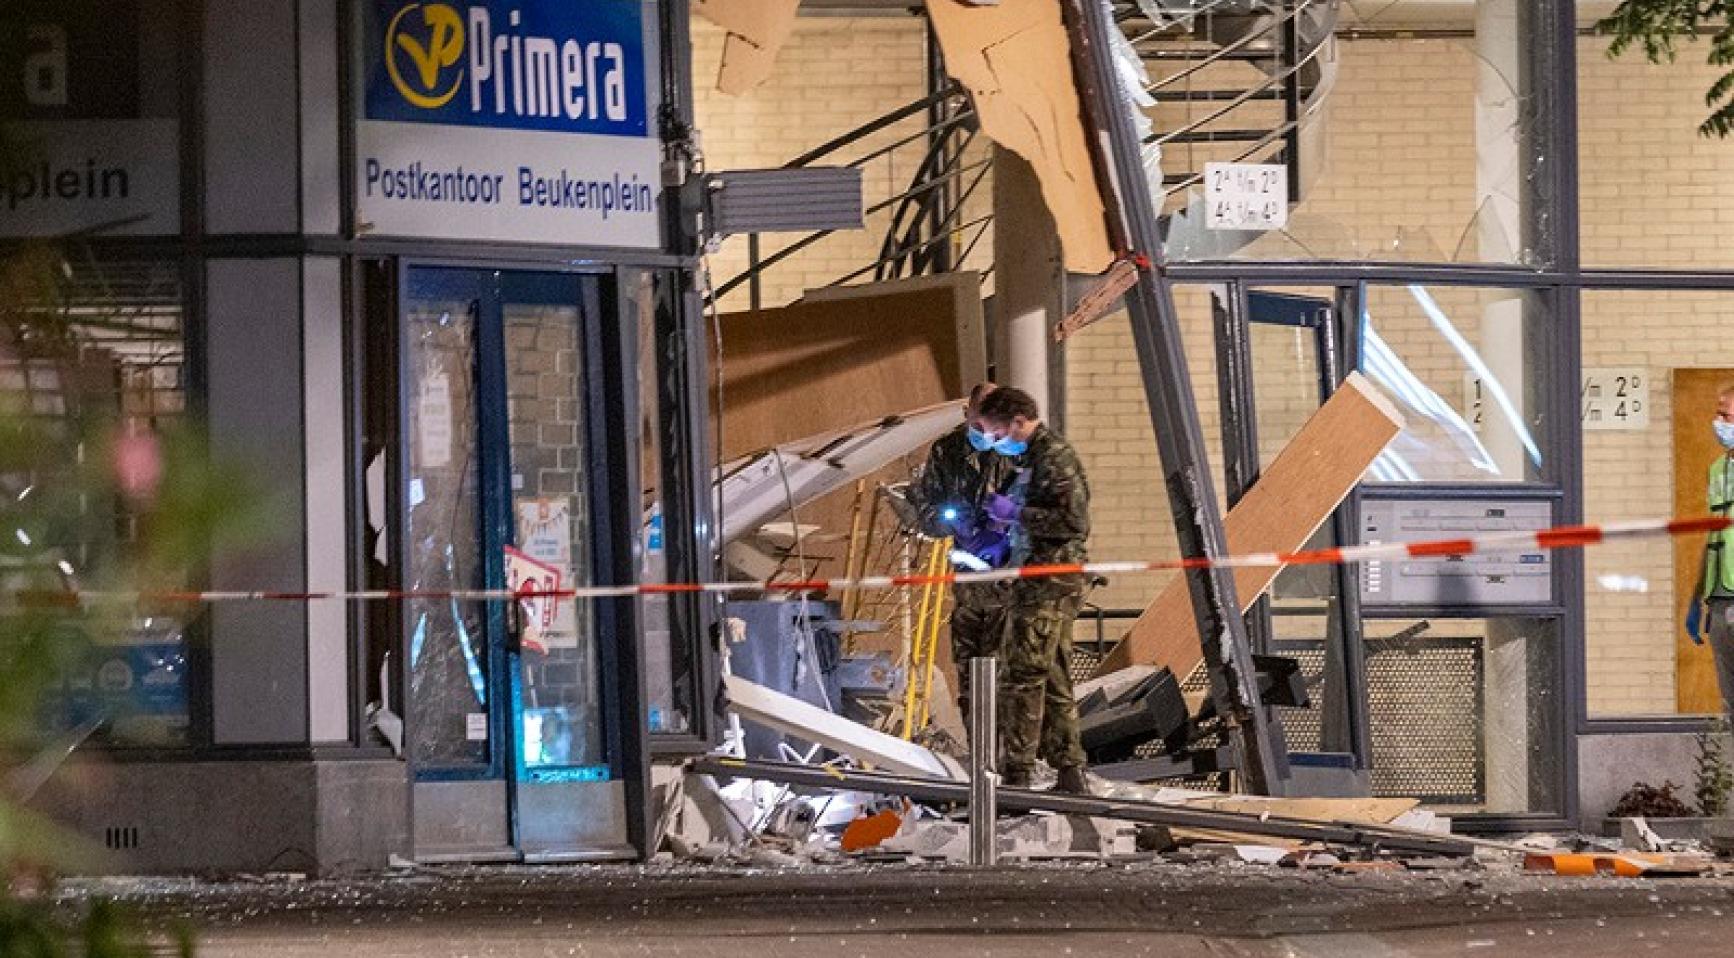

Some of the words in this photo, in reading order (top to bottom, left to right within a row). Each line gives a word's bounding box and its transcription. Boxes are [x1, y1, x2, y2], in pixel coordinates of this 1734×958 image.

[468, 5, 627, 122] Primera
[0, 159, 129, 211] plein
[366, 157, 503, 204] Postkantoor
[518, 166, 652, 220] Beukenplein
